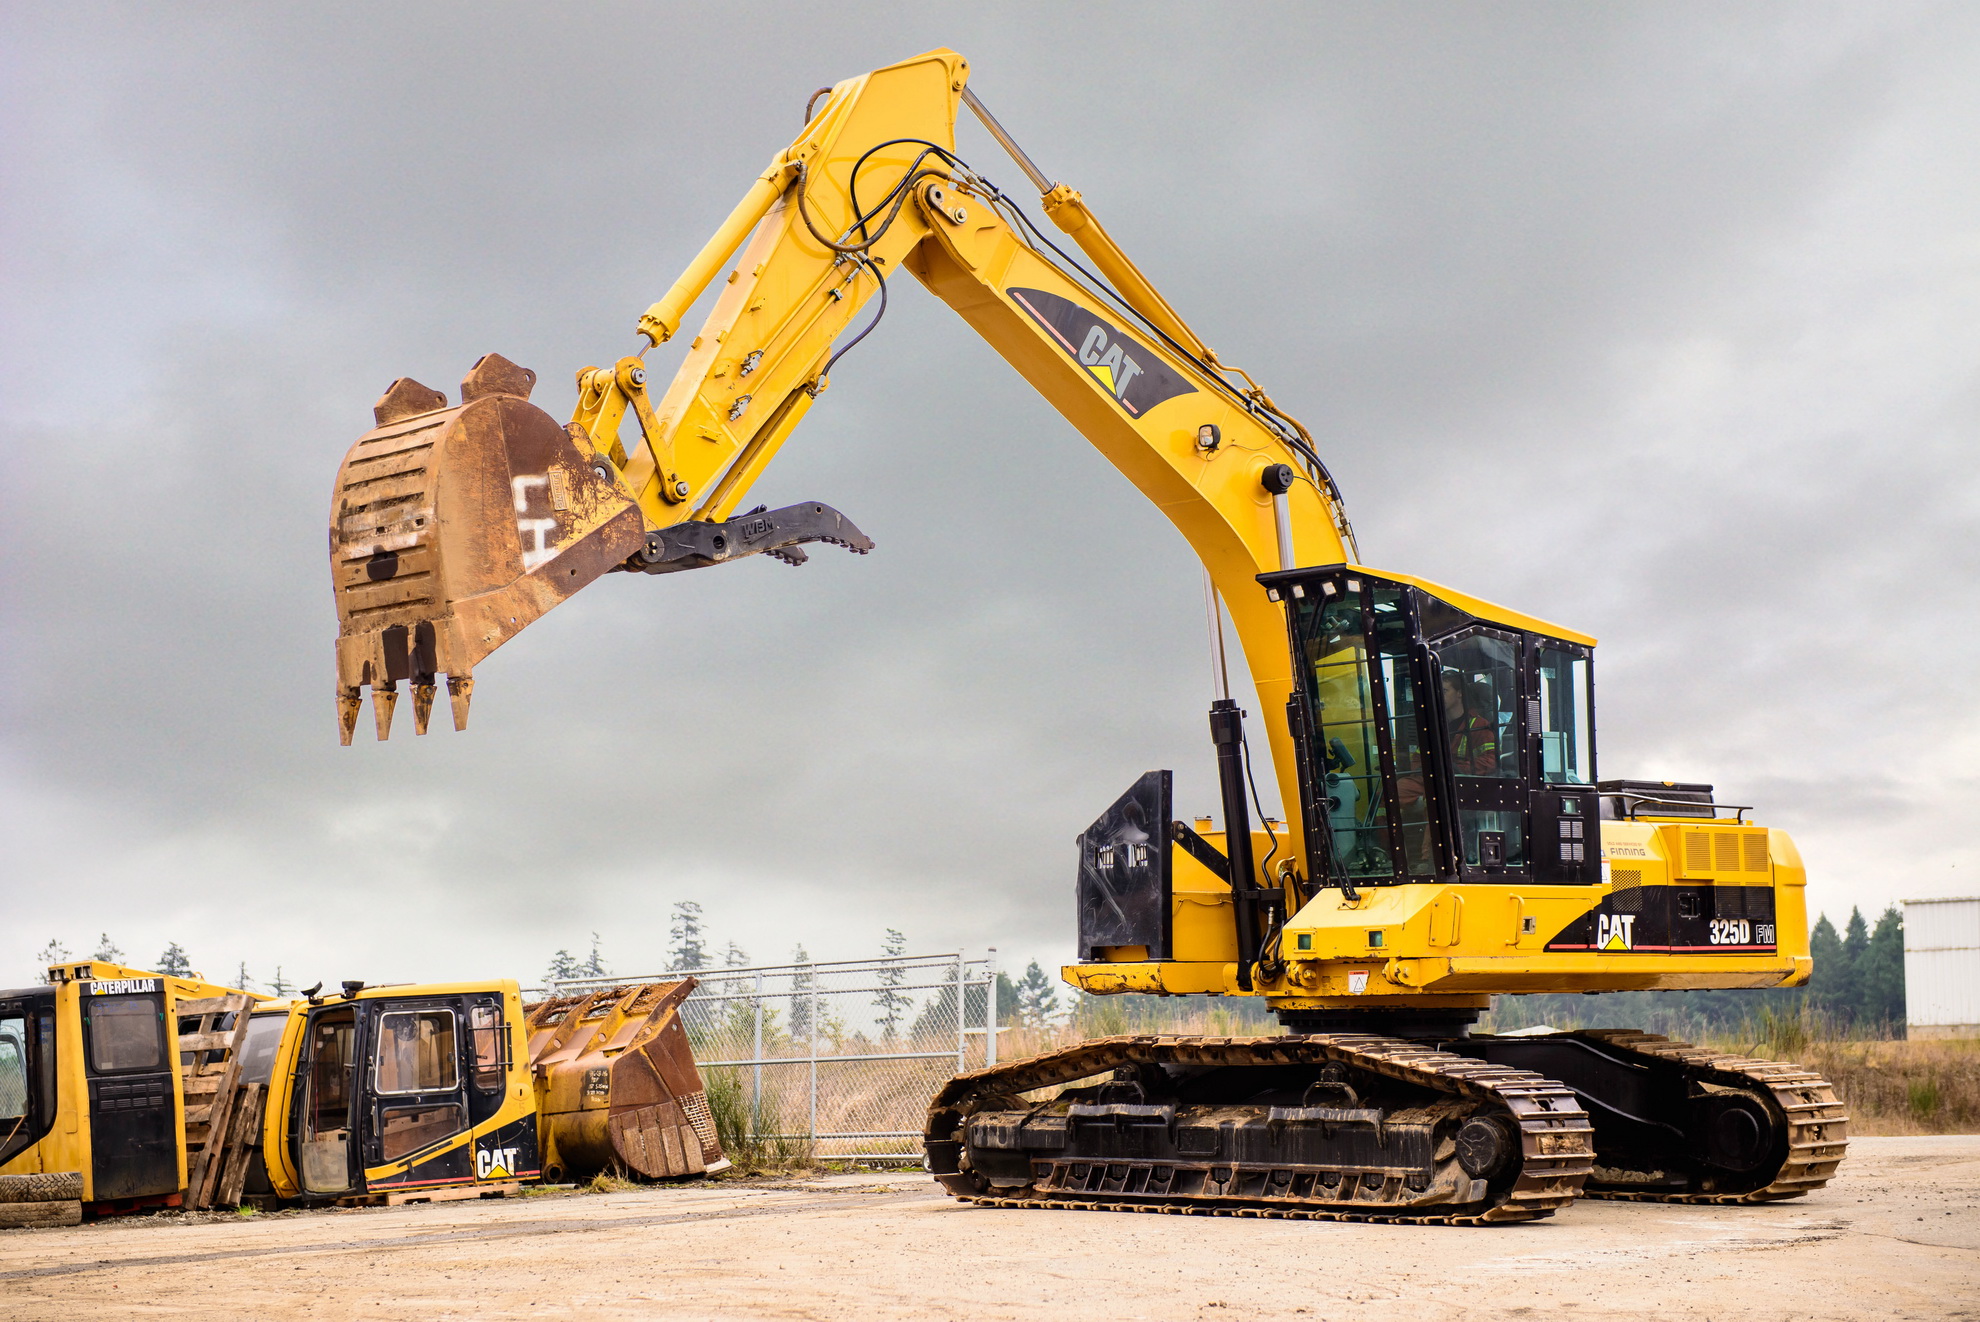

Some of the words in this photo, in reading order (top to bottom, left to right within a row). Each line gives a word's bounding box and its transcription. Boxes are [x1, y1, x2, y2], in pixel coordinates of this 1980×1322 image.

[1079, 325, 1141, 399] CAT
[742, 518, 774, 540] WBM
[1610, 847, 1646, 857] FINNING
[1597, 914, 1635, 950] CAT
[1709, 918, 1750, 945] 325D
[1755, 924, 1775, 944] FM
[90, 979, 156, 996] CATERPILLAR
[476, 1147, 517, 1179] CAT
